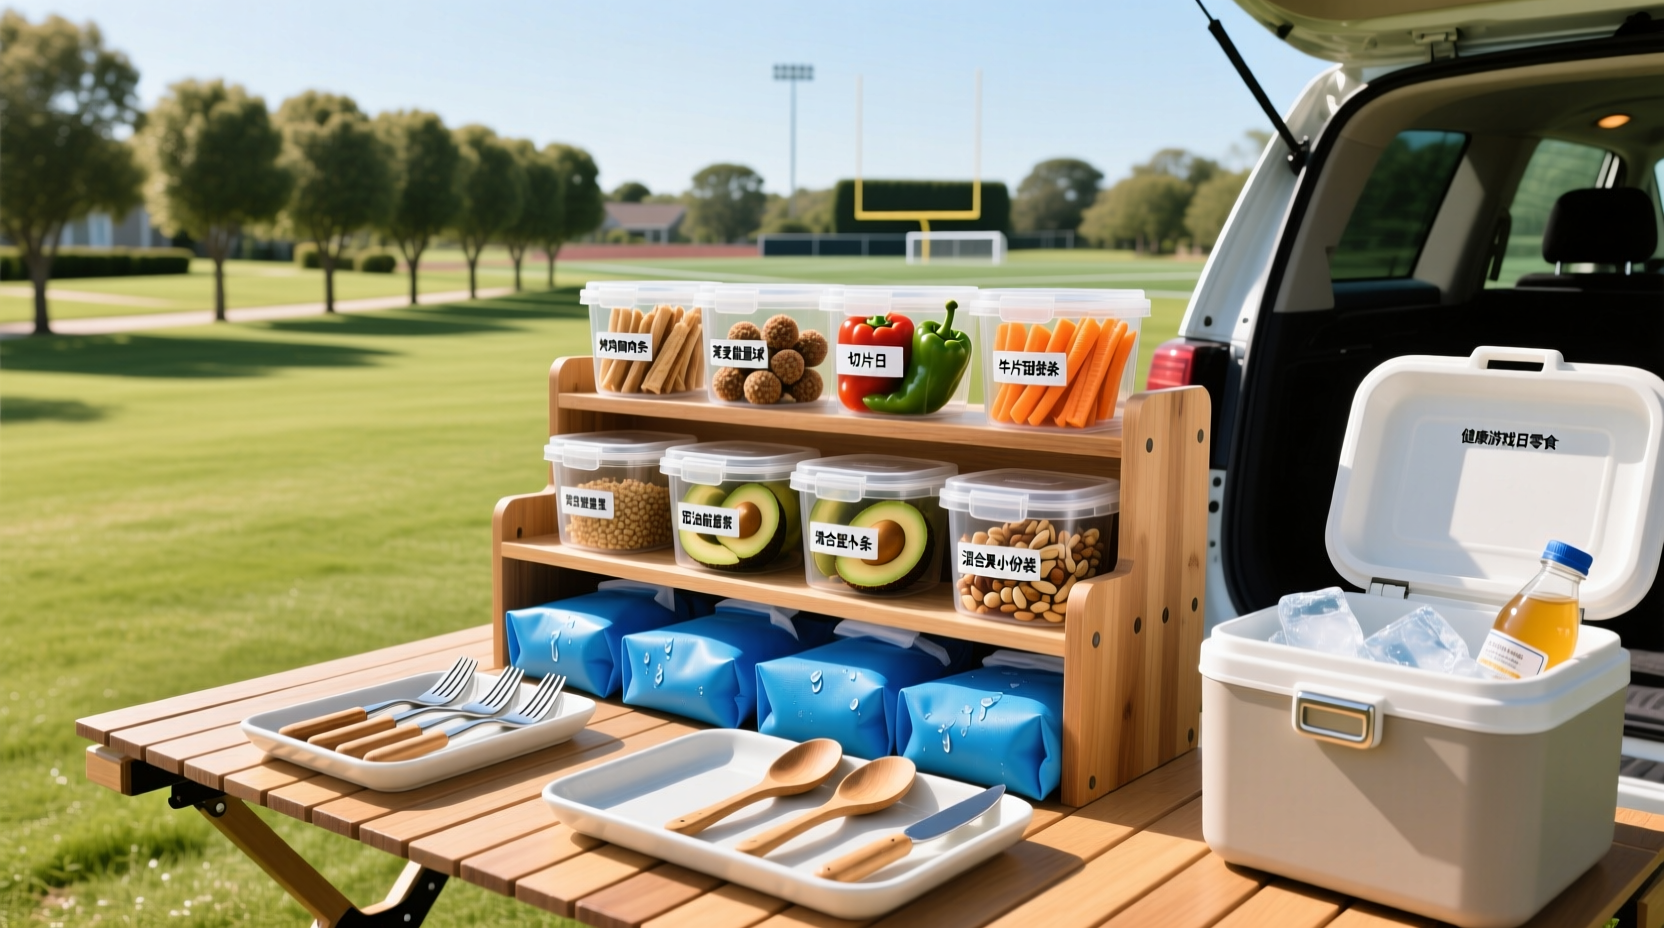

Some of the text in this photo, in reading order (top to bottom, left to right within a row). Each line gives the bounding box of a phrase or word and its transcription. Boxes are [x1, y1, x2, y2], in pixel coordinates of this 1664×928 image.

[1461, 427, 1560, 451] 健康游戏日零食
